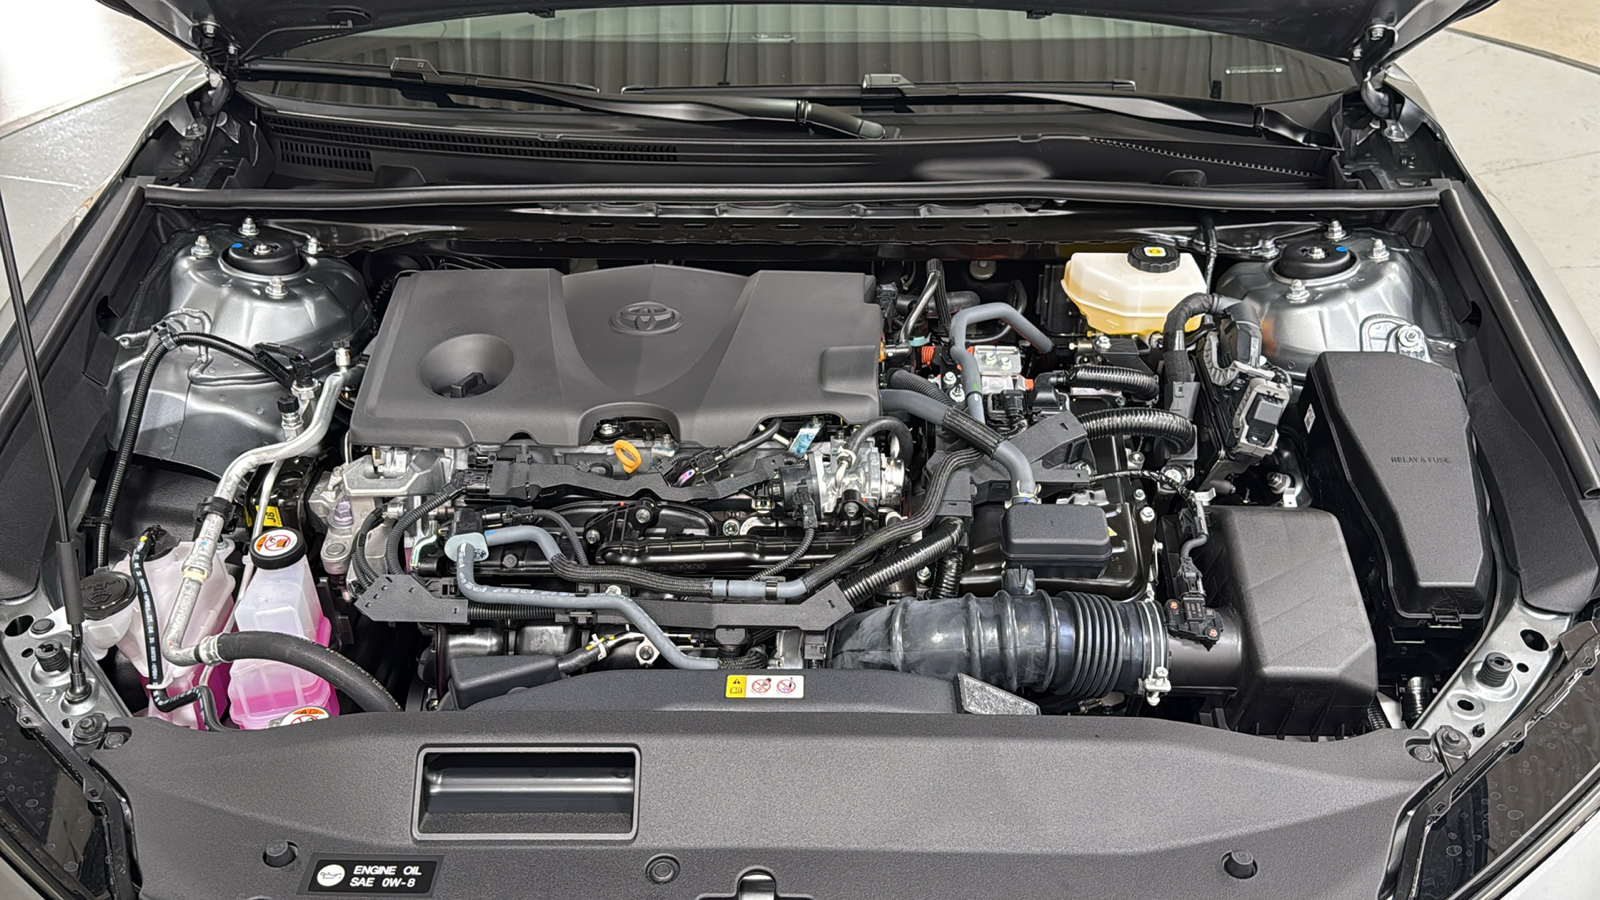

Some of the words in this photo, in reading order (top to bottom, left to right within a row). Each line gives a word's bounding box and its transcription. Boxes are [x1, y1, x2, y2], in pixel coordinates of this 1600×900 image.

[353, 865, 397, 875] ENGINE
[403, 866, 422, 875] OIL
[349, 877, 375, 887] SAE
[382, 878, 416, 887] 0W-8
